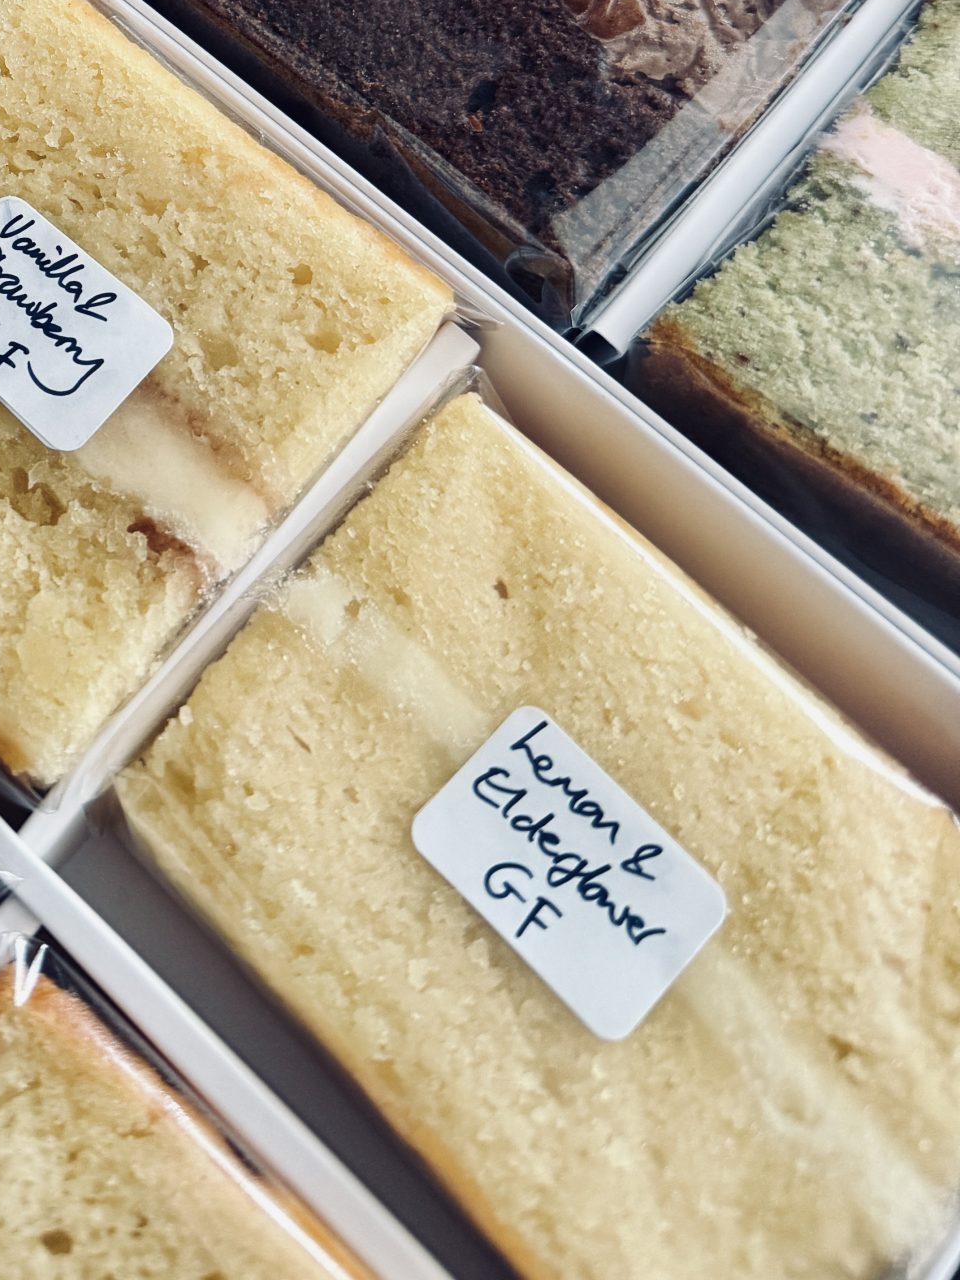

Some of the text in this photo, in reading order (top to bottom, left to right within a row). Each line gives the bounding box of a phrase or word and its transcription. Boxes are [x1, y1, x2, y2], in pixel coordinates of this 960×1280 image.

[473, 766, 666, 944] Elderflower
[509, 721, 662, 881] Lemon &
